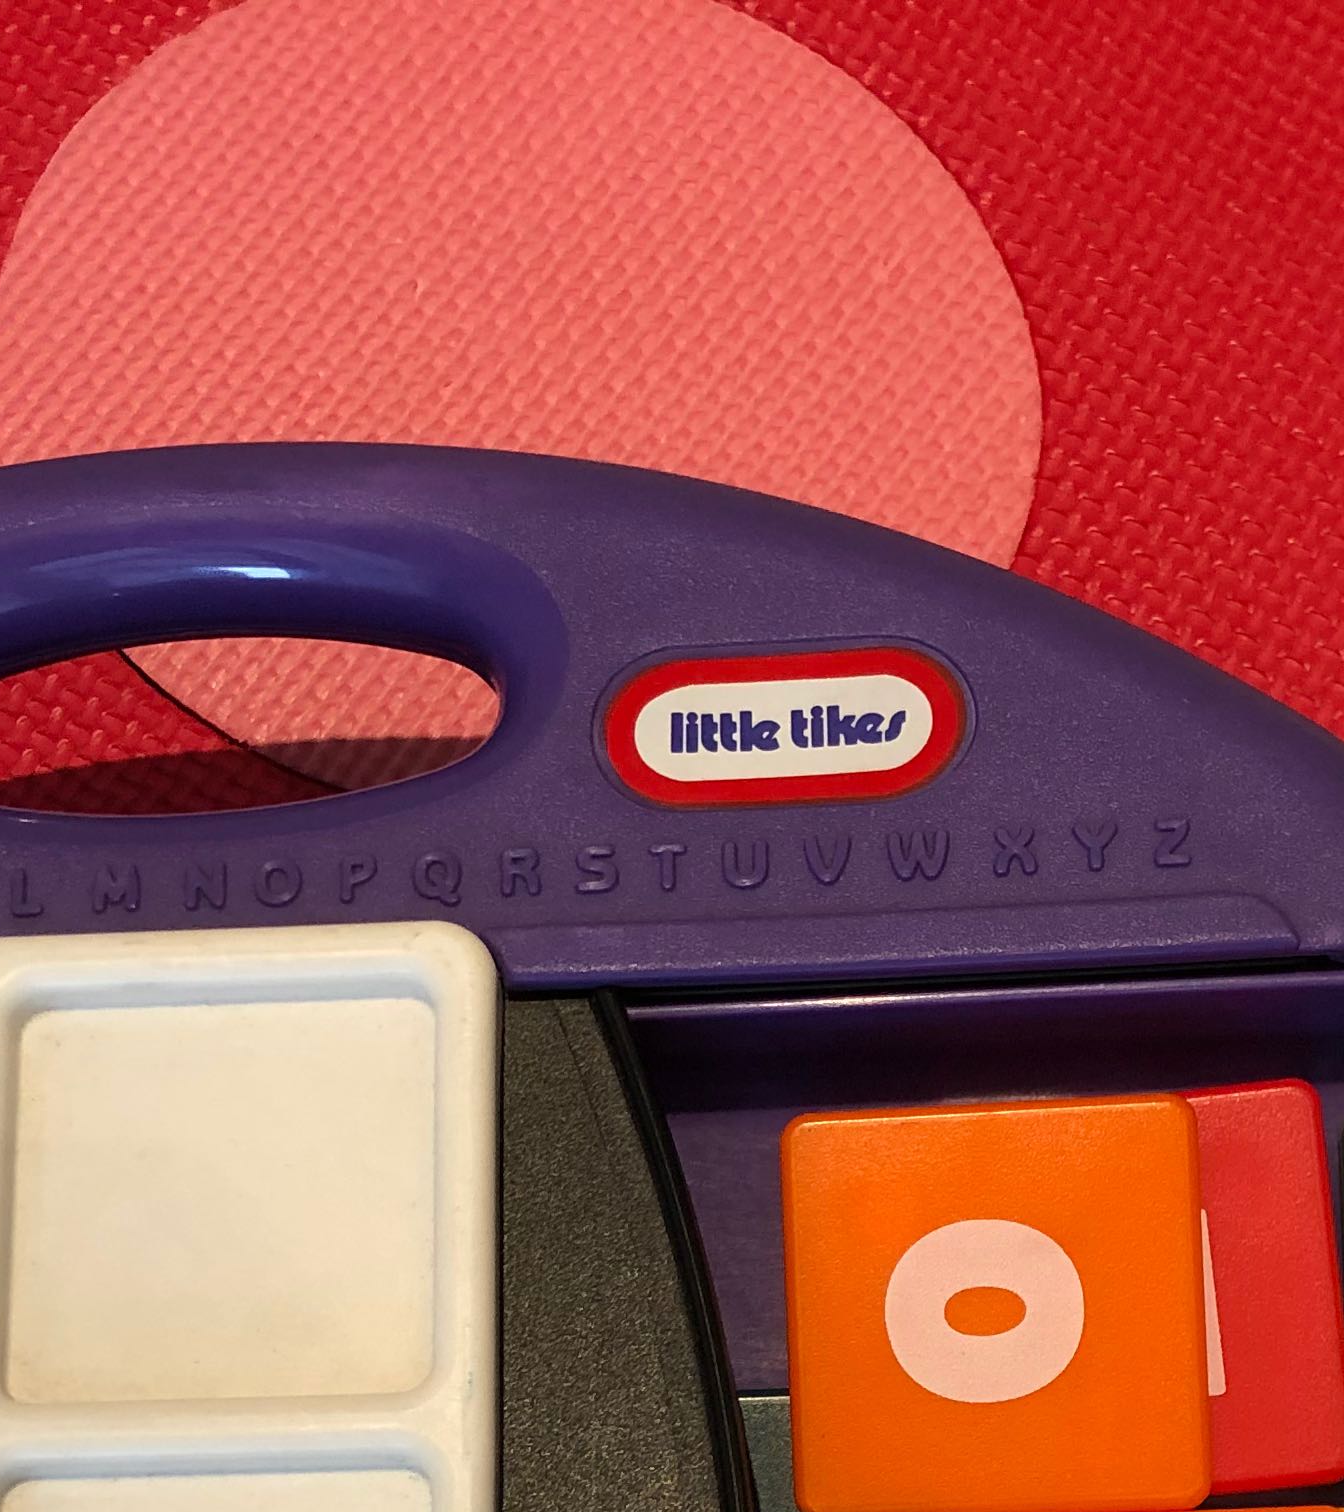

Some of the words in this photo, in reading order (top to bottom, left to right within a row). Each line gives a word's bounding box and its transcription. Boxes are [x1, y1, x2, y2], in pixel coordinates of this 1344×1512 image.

[669, 710, 782, 754] little
[790, 704, 907, 750] tikes
[11, 866, 44, 918] L
[91, 861, 141, 912] M
[183, 860, 228, 910] N
[256, 858, 303, 907] O
[339, 853, 376, 902] P
[411, 850, 463, 907] Q
[499, 846, 541, 897] R
[574, 844, 620, 894] S
[647, 843, 686, 892] T
[721, 840, 769, 890] U
[803, 834, 853, 885] V
[887, 830, 950, 880] W
[993, 825, 1038, 877] X
[1071, 818, 1118, 872] Y
[1153, 816, 1191, 868] Z
